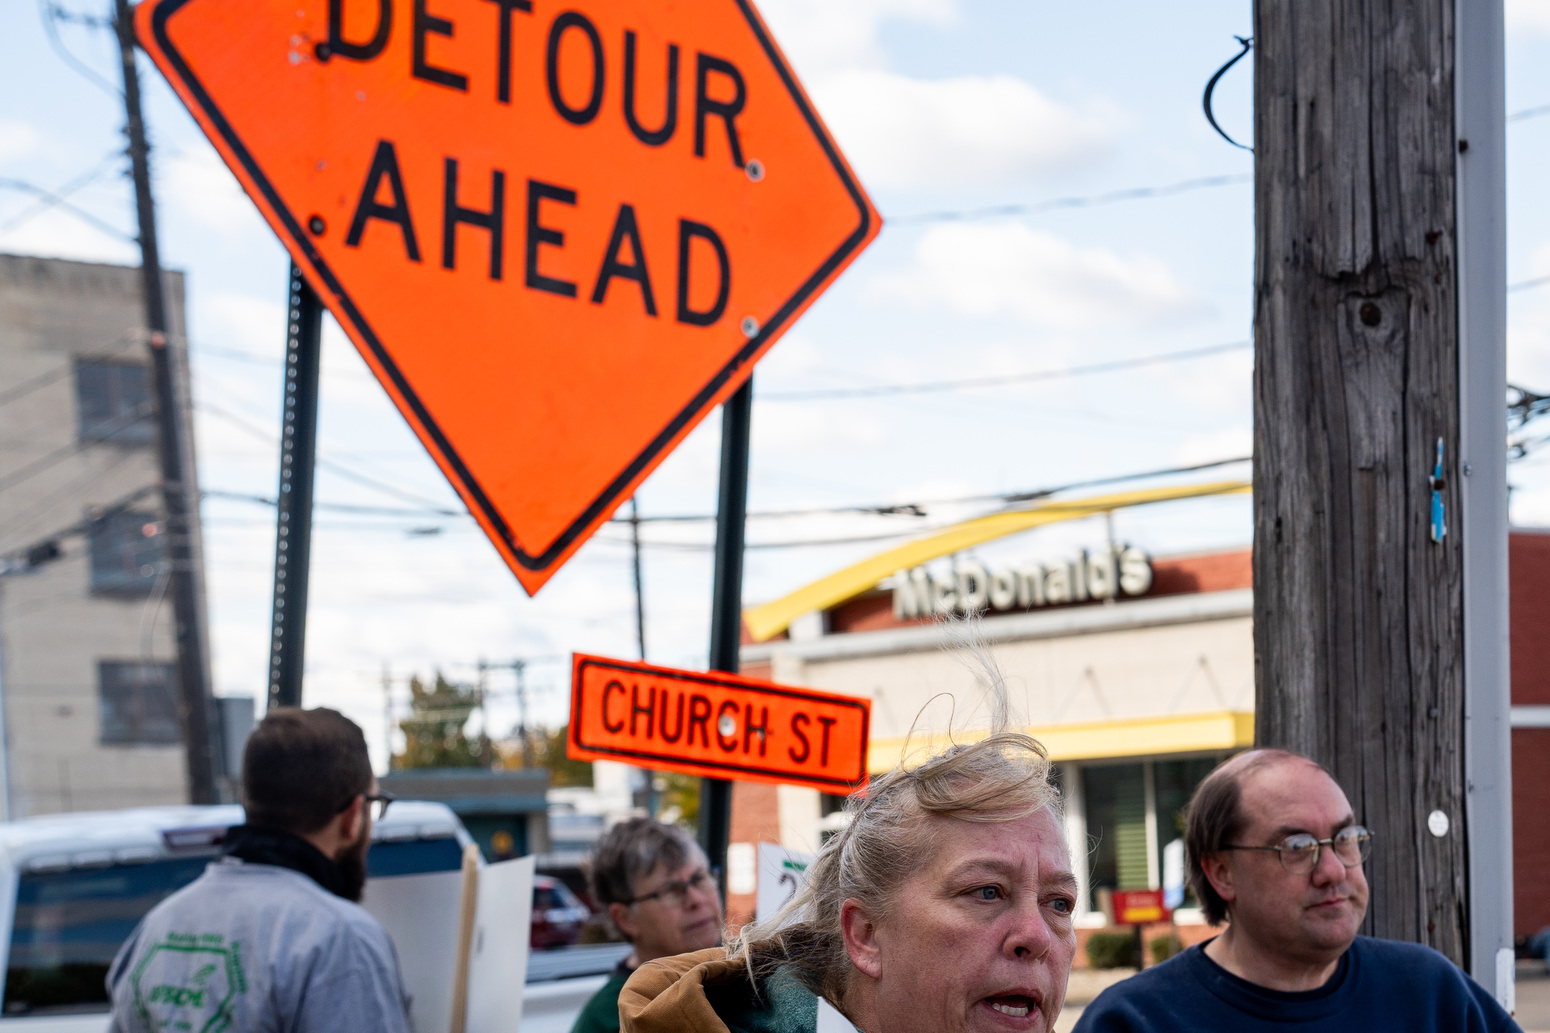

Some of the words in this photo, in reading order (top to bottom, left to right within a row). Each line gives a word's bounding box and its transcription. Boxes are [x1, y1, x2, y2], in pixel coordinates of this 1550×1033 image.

[328, 0, 746, 170] DETOUR
[344, 138, 730, 327] AHEAD
[893, 543, 1153, 619] McDonald's
[602, 680, 768, 757] CHURCH
[789, 712, 837, 767] ST
